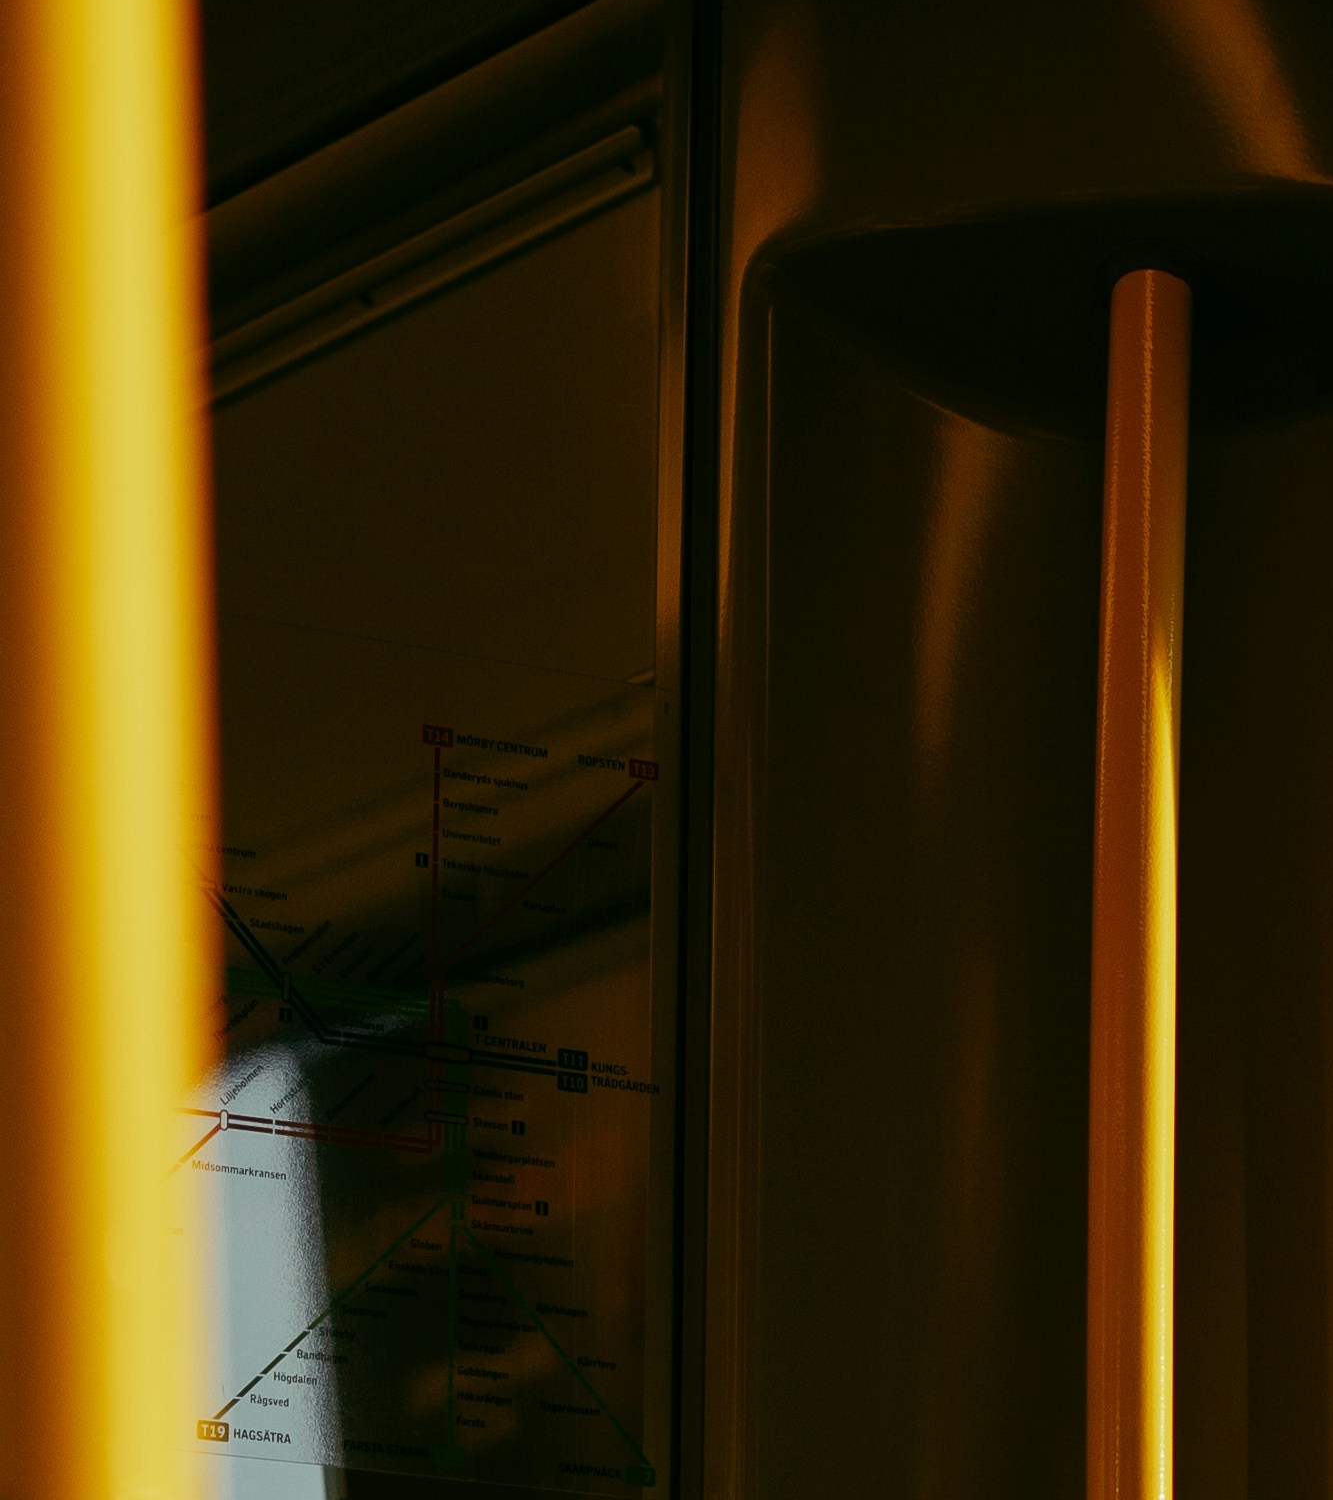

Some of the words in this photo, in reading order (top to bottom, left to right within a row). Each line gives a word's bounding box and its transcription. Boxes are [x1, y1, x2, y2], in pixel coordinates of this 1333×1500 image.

[426, 725, 450, 744] T14
[456, 734, 495, 751] MÖRBY
[496, 740, 549, 759] CENTRUM
[578, 754, 626, 772] ROPSTEN
[632, 761, 656, 779] T13
[442, 767, 492, 787] Danderyds
[492, 775, 529, 792] sjukhus
[442, 797, 499, 817] Bergshamra
[441, 829, 502, 847] Universitetet
[249, 917, 305, 936] Stadshagen
[474, 1032, 547, 1054] T-CENTRALEN
[561, 1051, 585, 1069] T11
[590, 1061, 631, 1078] KUNGS-
[561, 1074, 585, 1091] T10
[191, 1159, 288, 1182] Midsommarkransen
[249, 1393, 290, 1409] Rågsved
[200, 1423, 227, 1439] T19
[232, 1426, 292, 1445] HAGSÄTRA
[557, 1461, 623, 1480] SKARPNÄCK
